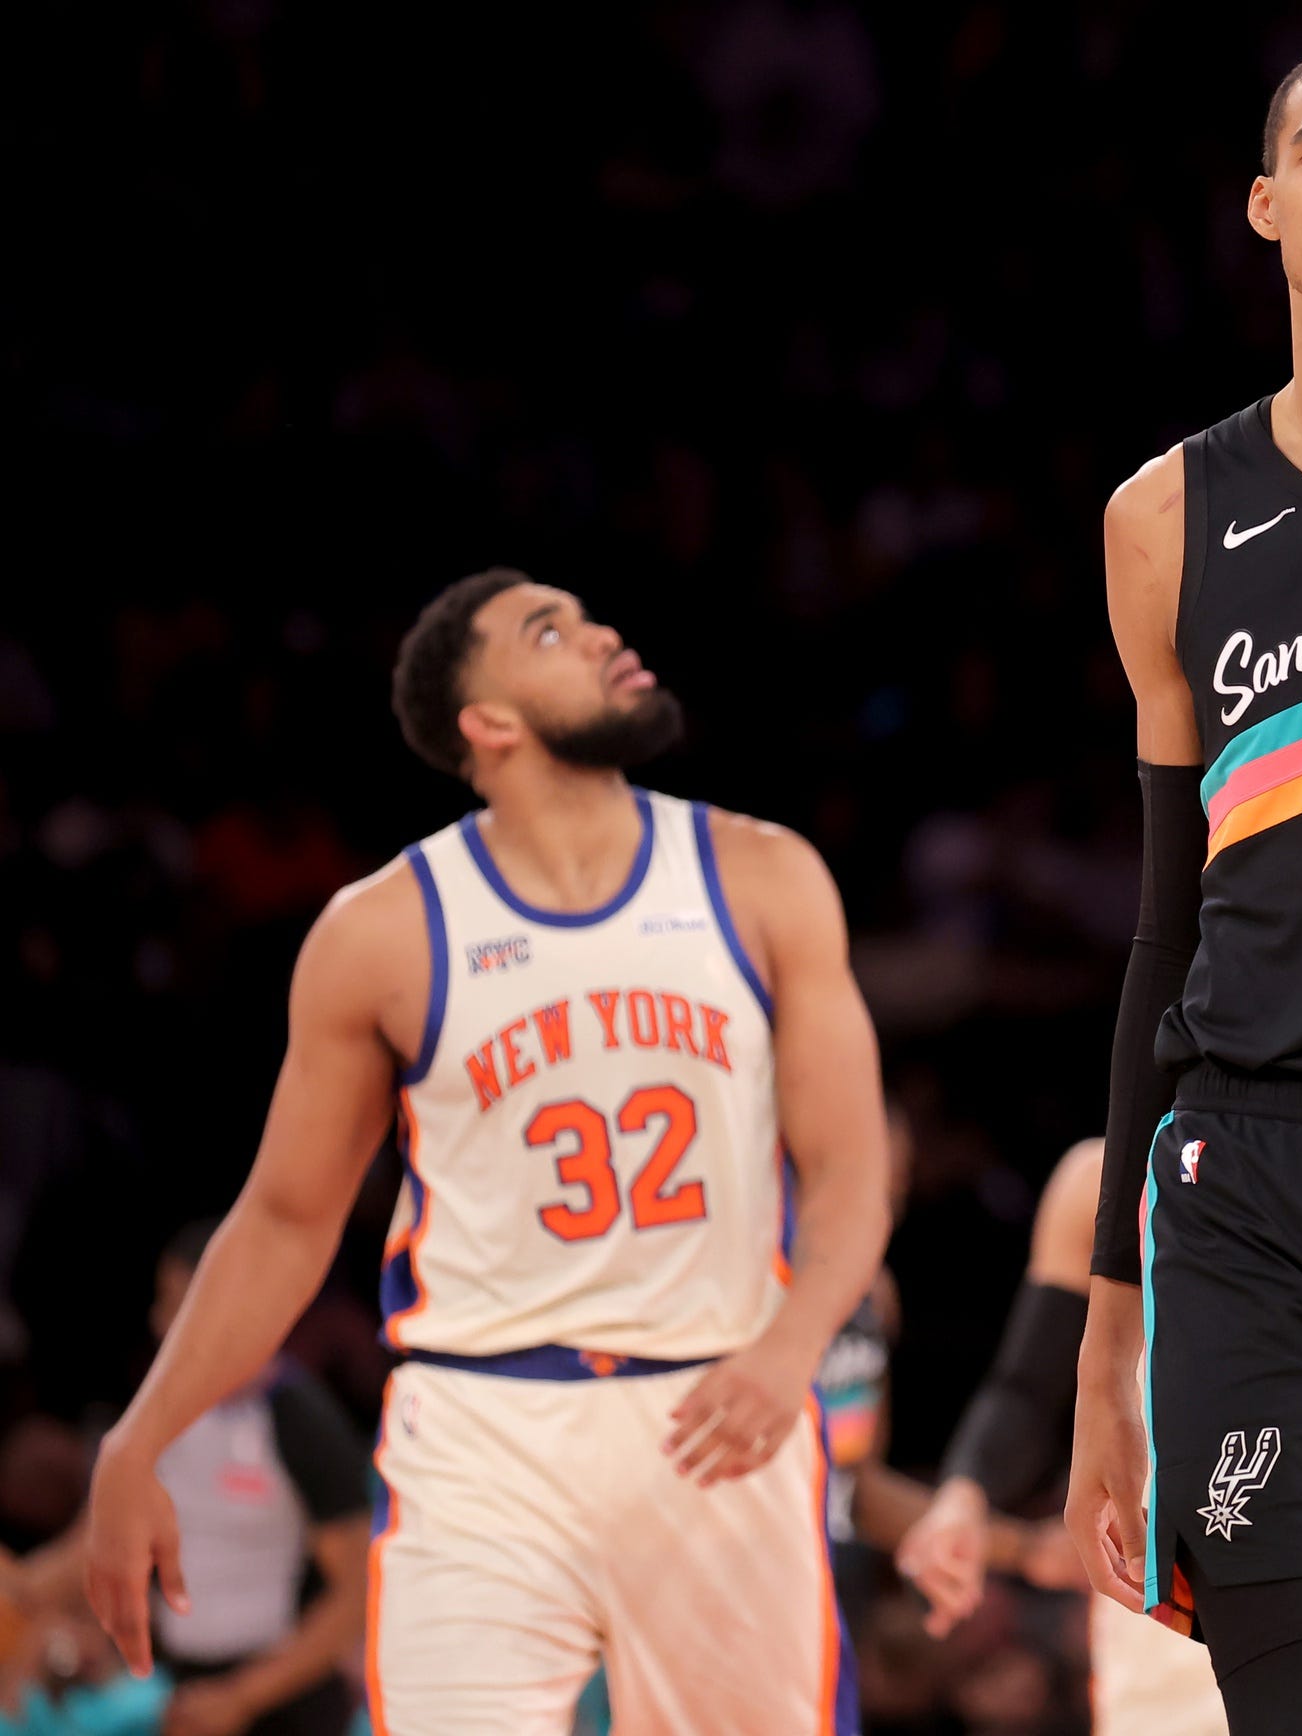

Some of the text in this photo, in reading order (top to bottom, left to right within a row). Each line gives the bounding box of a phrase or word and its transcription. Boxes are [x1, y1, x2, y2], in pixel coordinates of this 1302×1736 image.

[465, 989, 732, 1113] NEW YORK
[524, 1083, 707, 1242] 32
